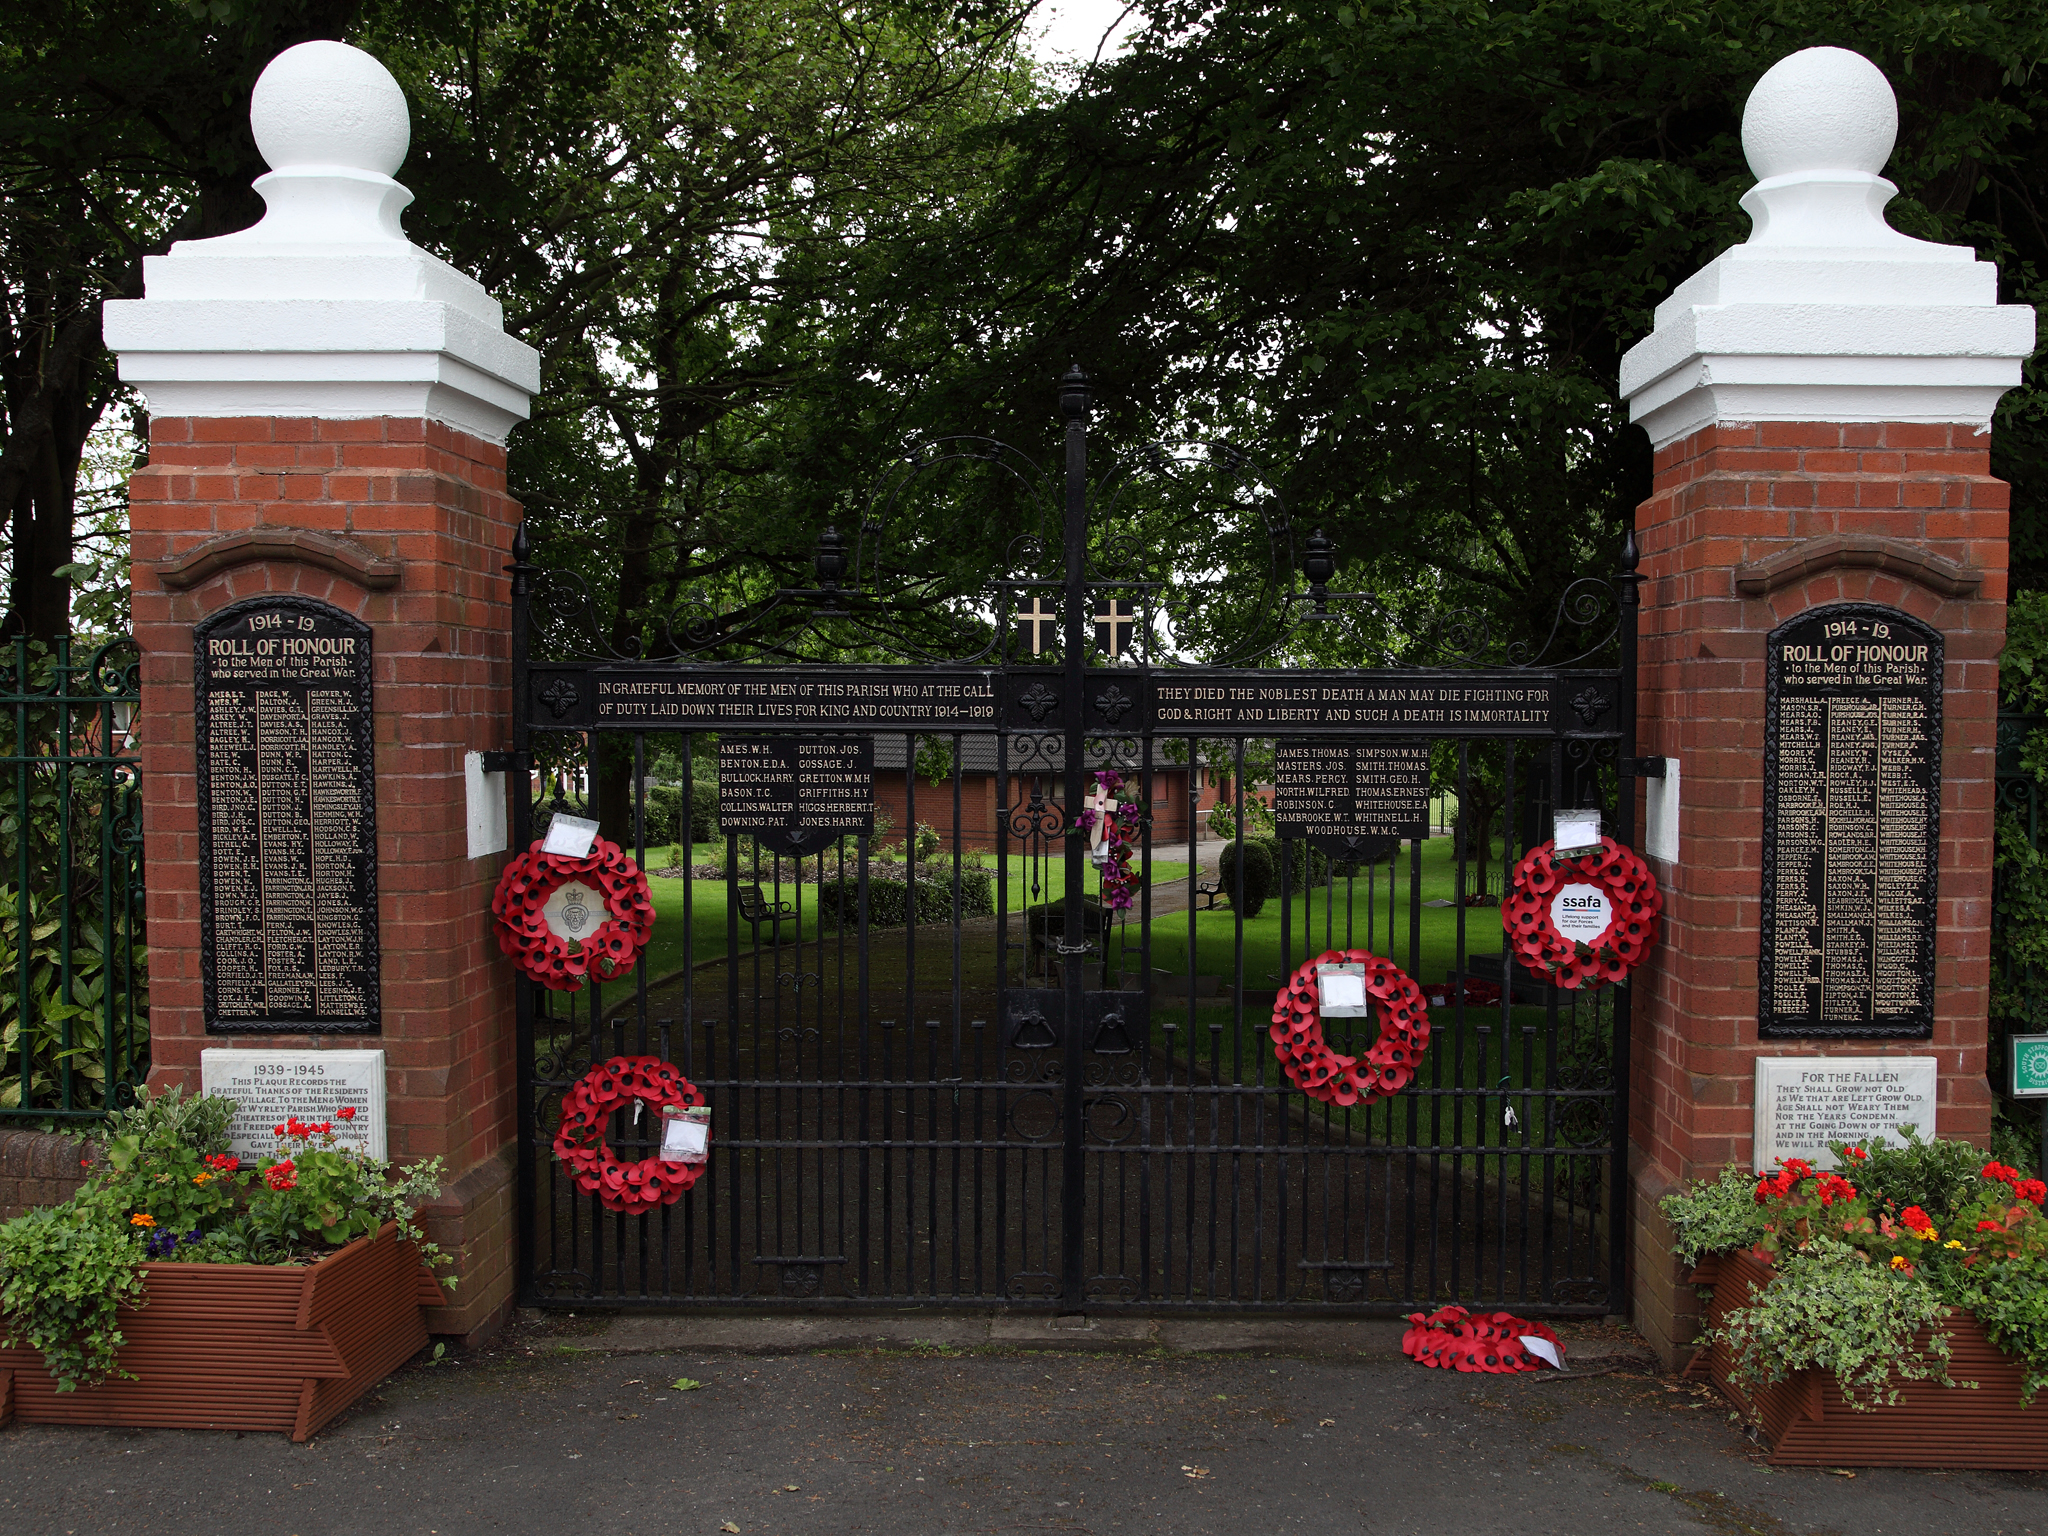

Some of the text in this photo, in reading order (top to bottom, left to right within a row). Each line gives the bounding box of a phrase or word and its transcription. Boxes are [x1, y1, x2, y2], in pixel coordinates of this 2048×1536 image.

[209, 638, 356, 656] ROLL OF HONOUR
[1783, 645, 1928, 662] ROLL OF HONOUR
[218, 656, 348, 667] to the Men of this Parish
[211, 669, 231, 679] who
[233, 669, 268, 678] served
[269, 669, 279, 678] in
[281, 668, 297, 678] the
[300, 668, 329, 678] Great
[1792, 663, 1920, 674] to the Men of this Parish
[1784, 675, 1804, 685] who
[1806, 675, 1841, 685] served
[1842, 675, 1852, 685] in
[1854, 675, 1871, 685] the
[1873, 675, 1902, 685] Great
[599, 683, 994, 697] IN GRATEFUL MEMORY OF THE MEN OF THIS PARISH WHO AT THE CALL
[1157, 688, 1550, 702] THEY DIED THE NOBLEST DEATH A MAN MAY DIE FIGHTING FOR
[599, 703, 613, 715] OF
[616, 703, 648, 715] DUTY
[650, 704, 679, 715] LAID
[681, 704, 715, 716] DOWN
[718, 704, 754, 716] THEIR
[758, 704, 792, 716] LIVES
[795, 704, 817, 716] FOR
[820, 705, 850, 717] KING
[852, 705, 877, 717] AND
[879, 705, 932, 717] COUNTRY
[1157, 708, 1182, 720] GOD
[1194, 708, 1232, 720] RIGHT
[1237, 708, 1264, 720] AND
[1267, 709, 1320, 721] LIBERTY
[1325, 709, 1350, 721] AND
[1355, 709, 1388, 721] SUCH
[1392, 709, 1400, 721] A
[1404, 709, 1444, 721] DEATH
[1450, 710, 1462, 721] IS
[1464, 710, 1549, 722] IMMORTALITY
[1563, 895, 1601, 908] ssafa
[231, 1078, 347, 1086] THIS PLAQUE RECORDS THE
[1801, 1073, 1899, 1083] FOR THE FALLEN
[210, 1087, 368, 1095] GRATEFUL THANKS OF THE RESIDENTS
[1776, 1085, 1905, 1093] THEY SHALL GROW NOT OLD
[291, 1096, 368, 1104] THE MEN WOMEN
[1776, 1094, 1787, 1102] AS
[1789, 1094, 1804, 1102] WE
[1806, 1094, 1829, 1102] THAT
[1831, 1094, 1849, 1102] ARE
[1851, 1094, 1874, 1102] LEFT
[1876, 1094, 1902, 1102] GROW
[250, 1105, 285, 1113] WYRLEY
[1776, 1103, 1910, 1111] AGE SHALL NOT WEARY THEM
[235, 1114, 332, 1122] THEATRES IN THE
[1776, 1131, 1794, 1139] AND
[1795, 1131, 1805, 1139] IN
[1807, 1131, 1824, 1139] THE
[1776, 1140, 1814, 1148] WE WILL
